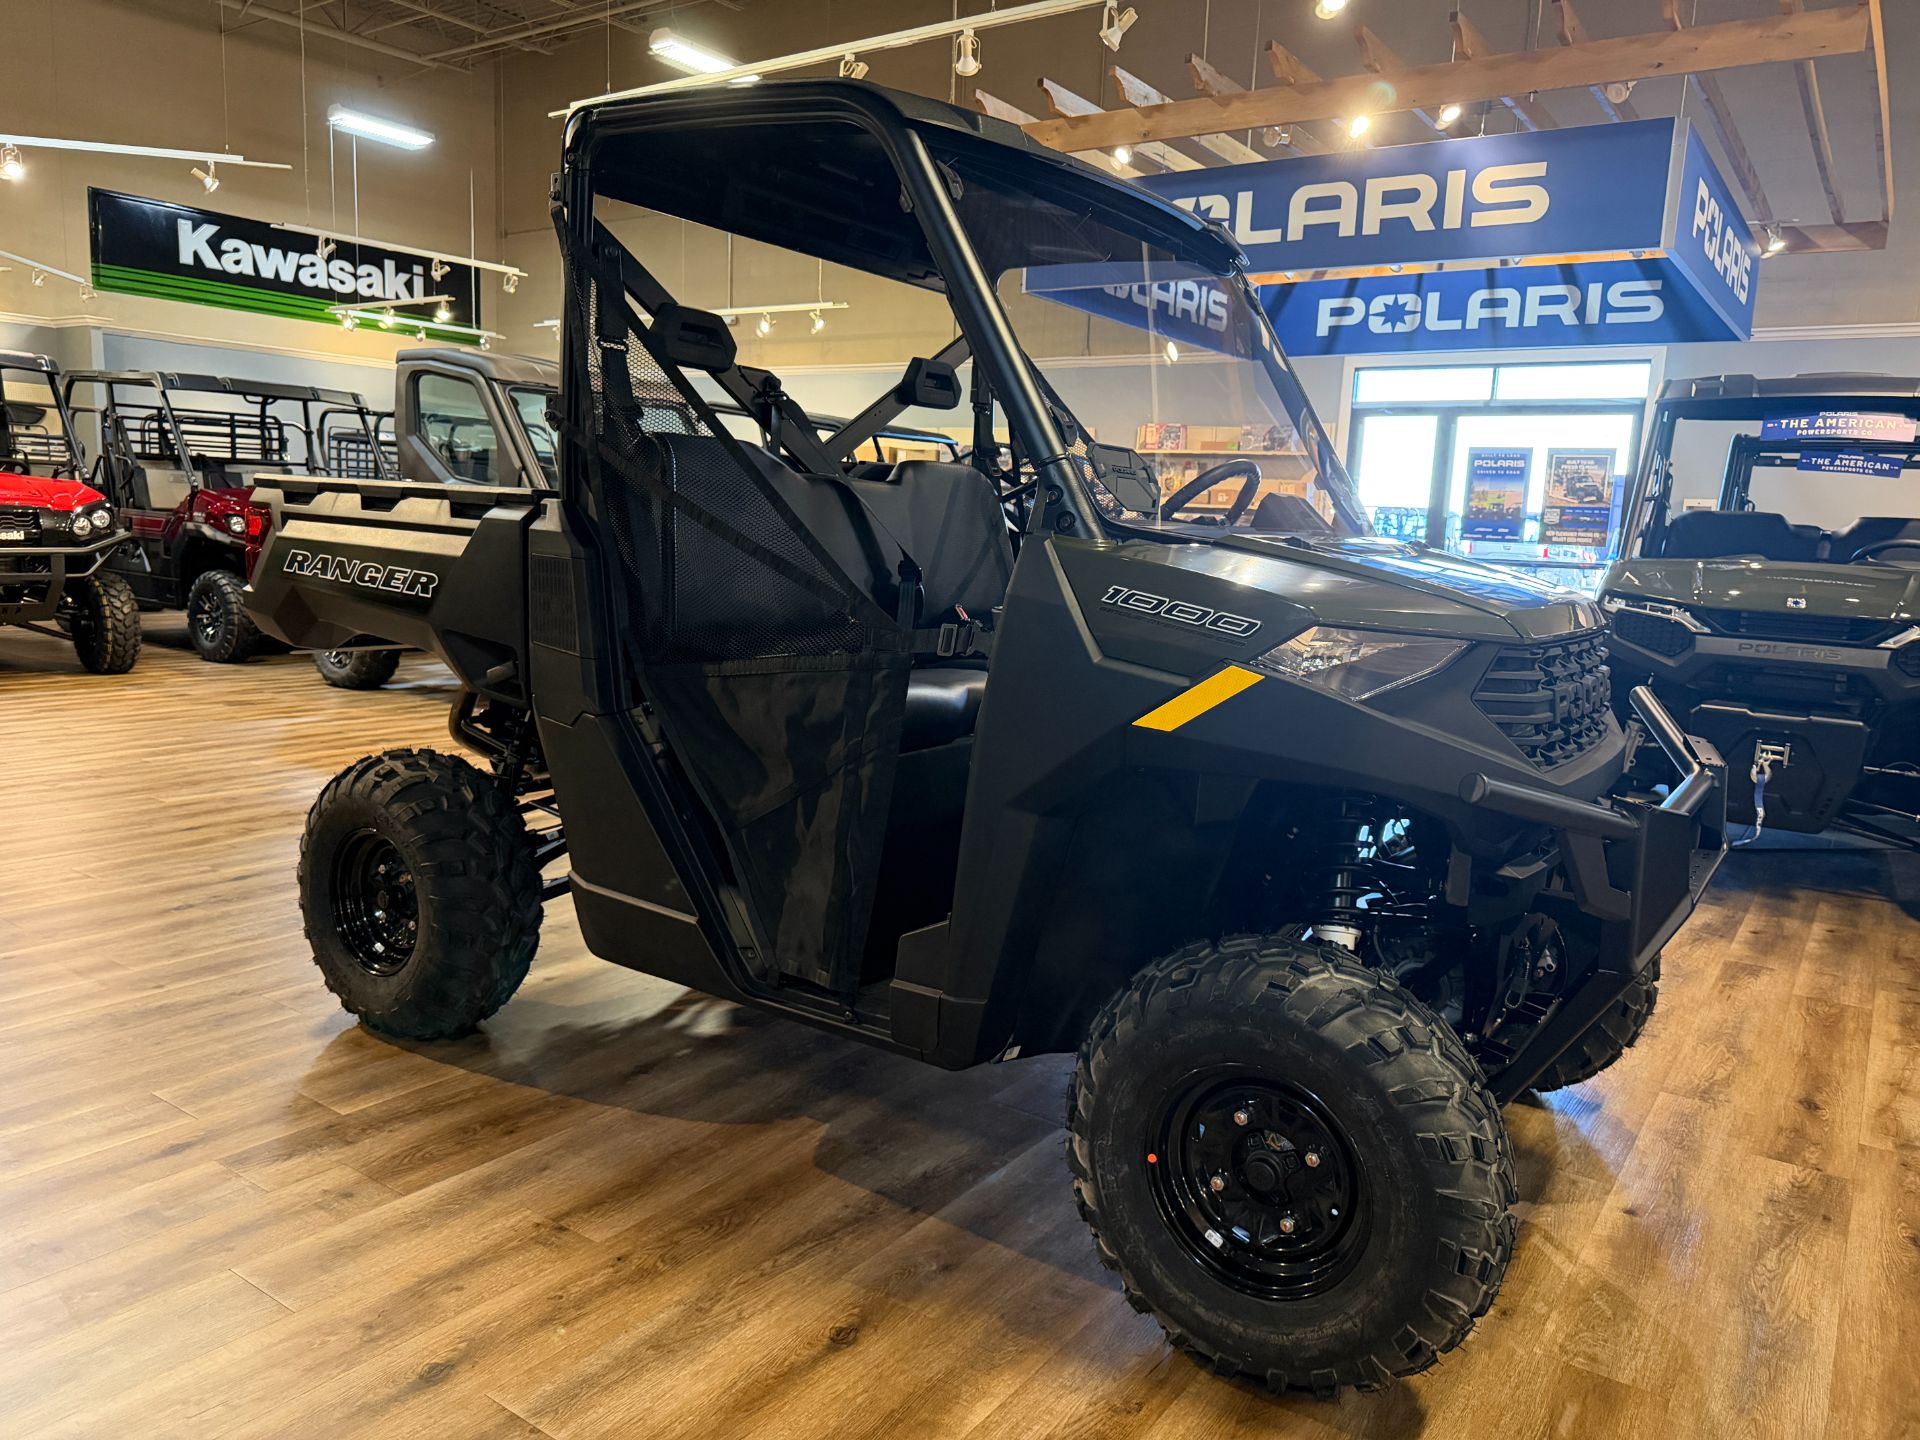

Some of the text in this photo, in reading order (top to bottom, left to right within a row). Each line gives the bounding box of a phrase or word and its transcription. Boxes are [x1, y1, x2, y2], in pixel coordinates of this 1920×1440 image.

[1171, 161, 1550, 245] LARIS
[177, 218, 424, 299] Kawasaki
[1692, 176, 1751, 305] POLARIS
[1316, 280, 1664, 337] POLARIS
[1780, 418, 1897, 429] THE AMERICAN
[1474, 459, 1525, 467] POLARIS
[1811, 457, 1890, 470] THE AMERICAN
[1821, 465, 1864, 473] POWERSPORTS
[283, 549, 439, 598] RANGER
[1101, 585, 1264, 637] 1000
[1738, 643, 1841, 659] POLARIS
